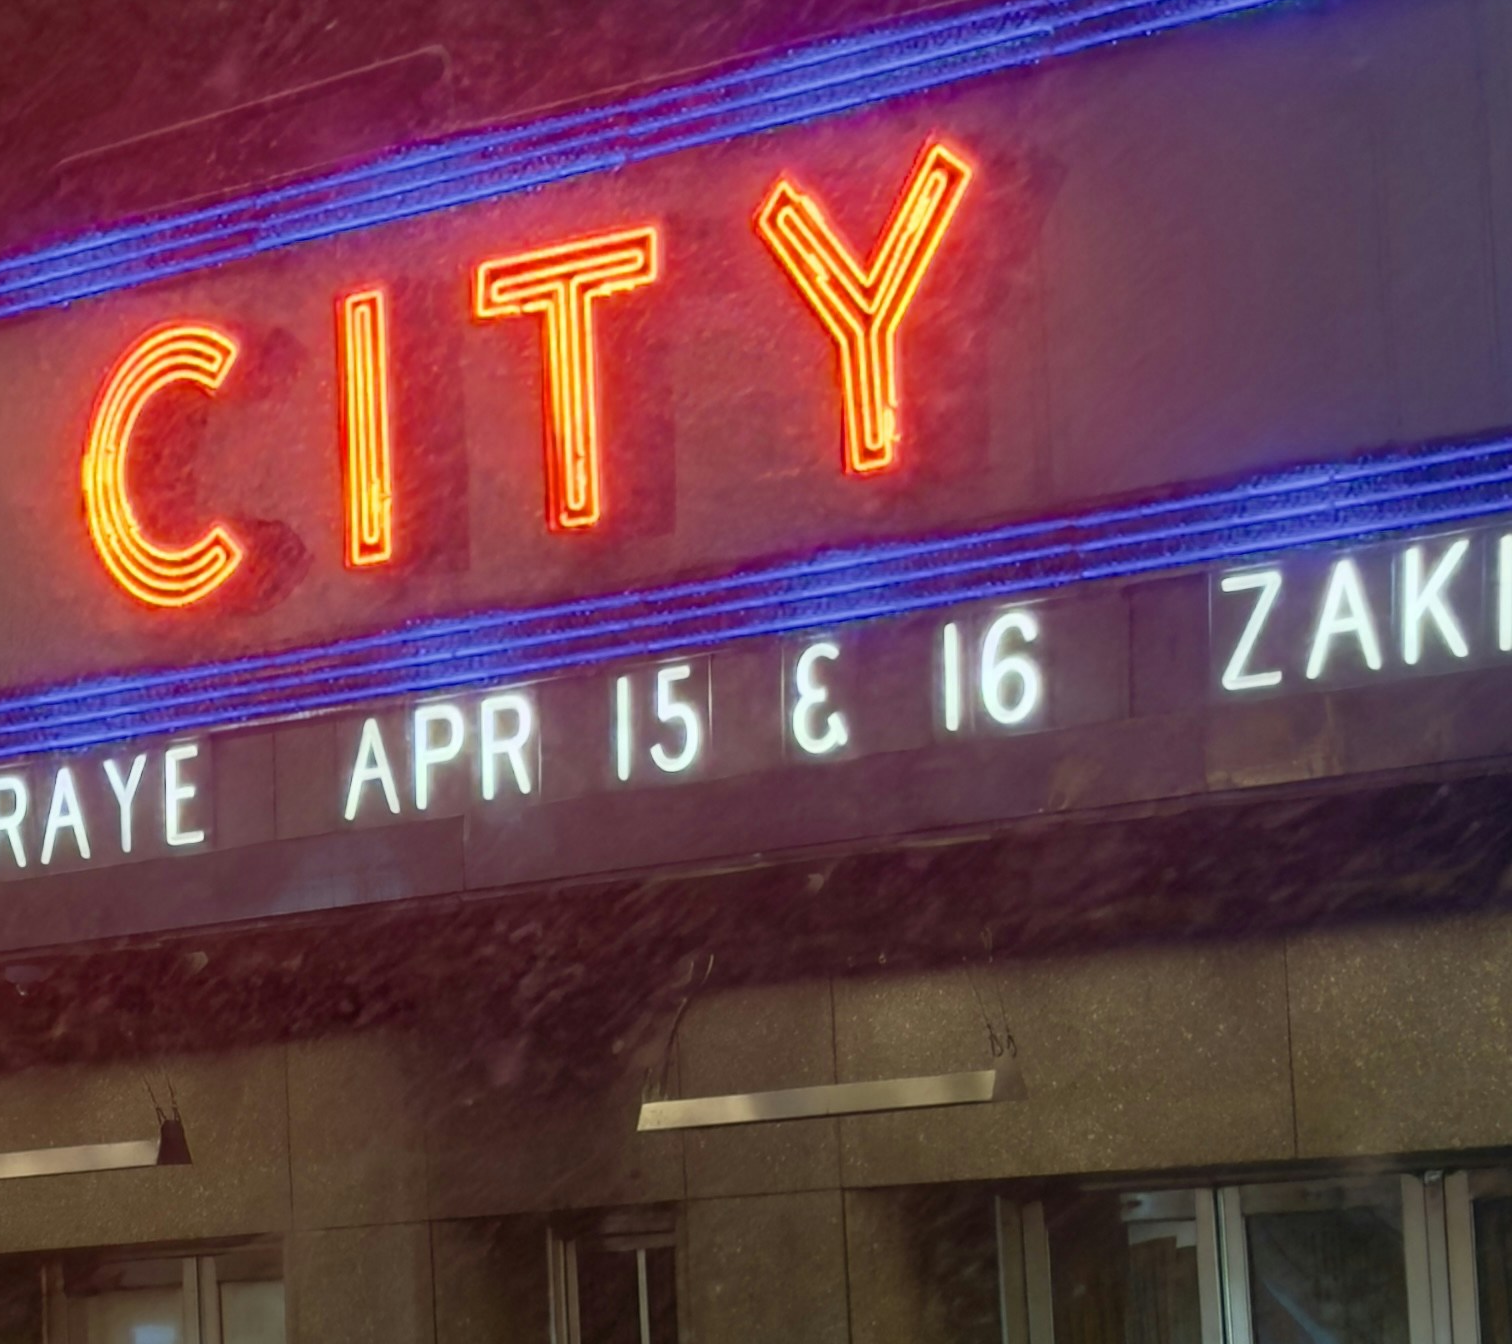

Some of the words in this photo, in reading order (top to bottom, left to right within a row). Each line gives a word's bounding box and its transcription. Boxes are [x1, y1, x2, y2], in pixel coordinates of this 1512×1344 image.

[81, 142, 974, 609] CITY
[343, 691, 534, 823] APR
[616, 664, 702, 783] 15
[792, 642, 848, 755] &
[943, 611, 1039, 733] 16
